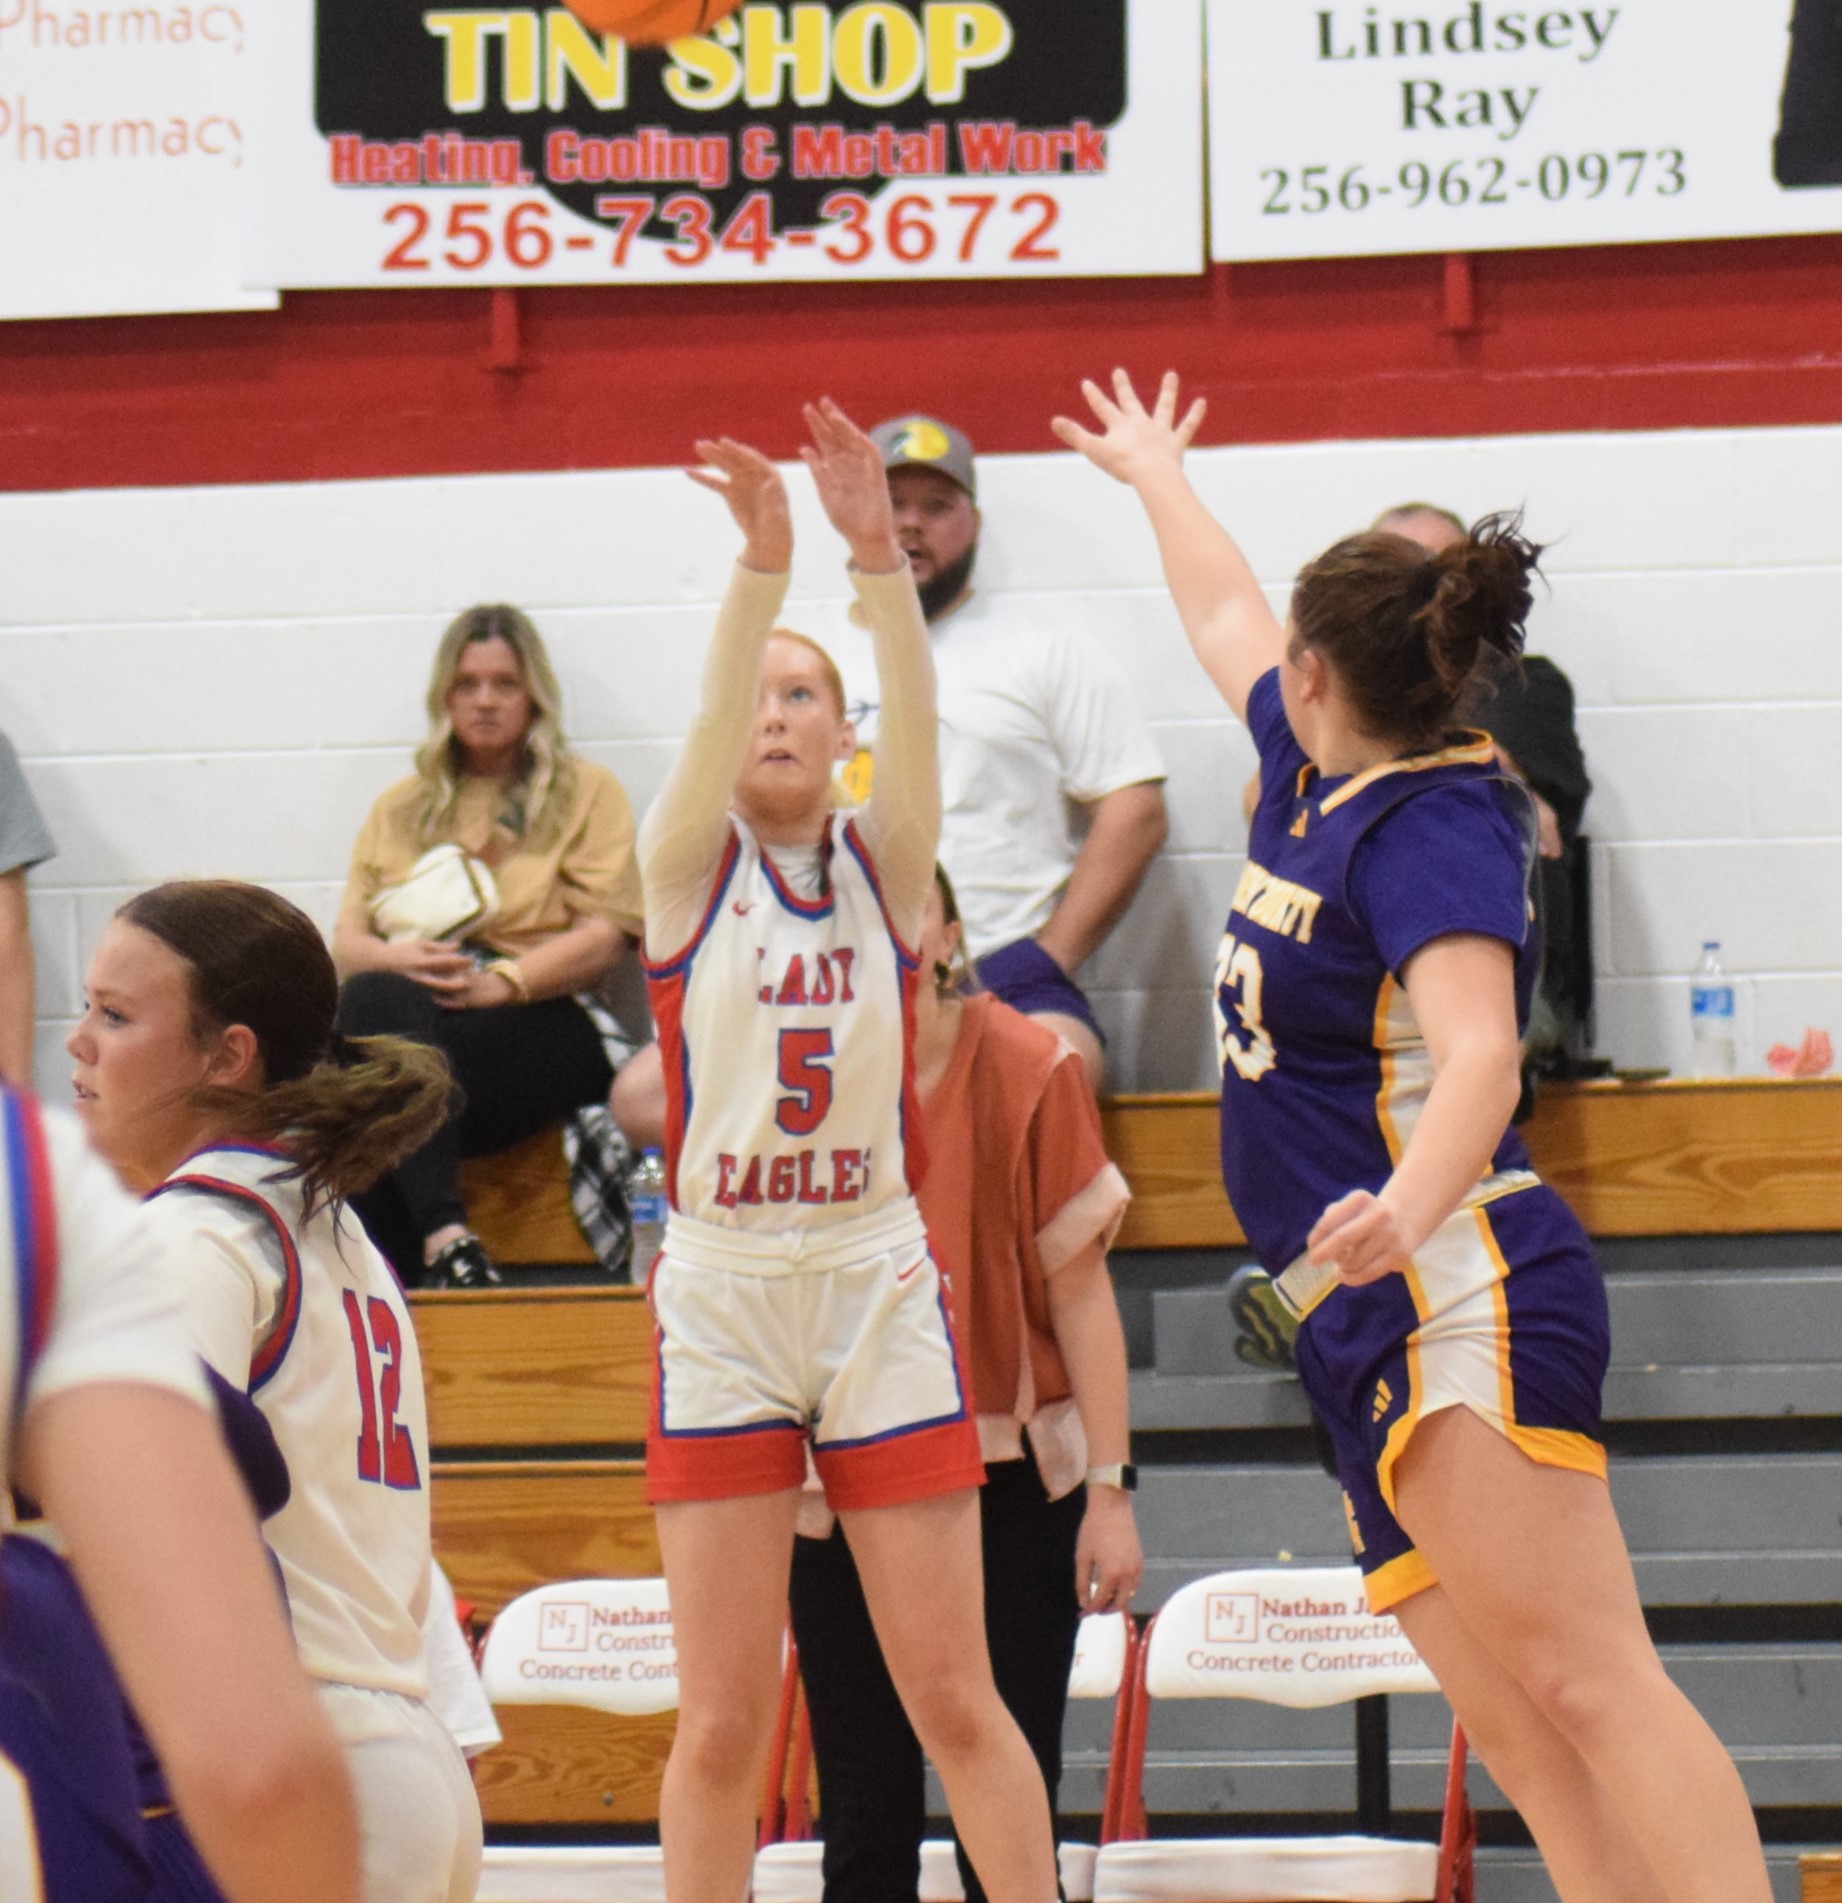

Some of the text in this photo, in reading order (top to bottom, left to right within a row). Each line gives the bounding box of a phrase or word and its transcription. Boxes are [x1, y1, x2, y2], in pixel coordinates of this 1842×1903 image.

[425, 2, 1012, 112] TIN SHOP
[1315, 0, 1619, 62] Lindsey
[1400, 78, 1540, 140] Ray
[330, 121, 1108, 187] Heating, Cooling & Metal Work
[1259, 147, 1687, 215] 256-962-0973
[381, 191, 1060, 270] 256-734-3672
[757, 947, 855, 1005] ADY
[774, 1027, 835, 1136] 5
[714, 1147, 870, 1208] EAGLE
[342, 1287, 421, 1490] 12
[592, 1607, 673, 1627] Nathan
[1262, 1598, 1346, 1617] Nathan
[1266, 1622, 1401, 1643] Constructio
[519, 1659, 622, 1681] Concrete
[596, 1632, 674, 1652] Constr
[1186, 1651, 1294, 1672] Concrete
